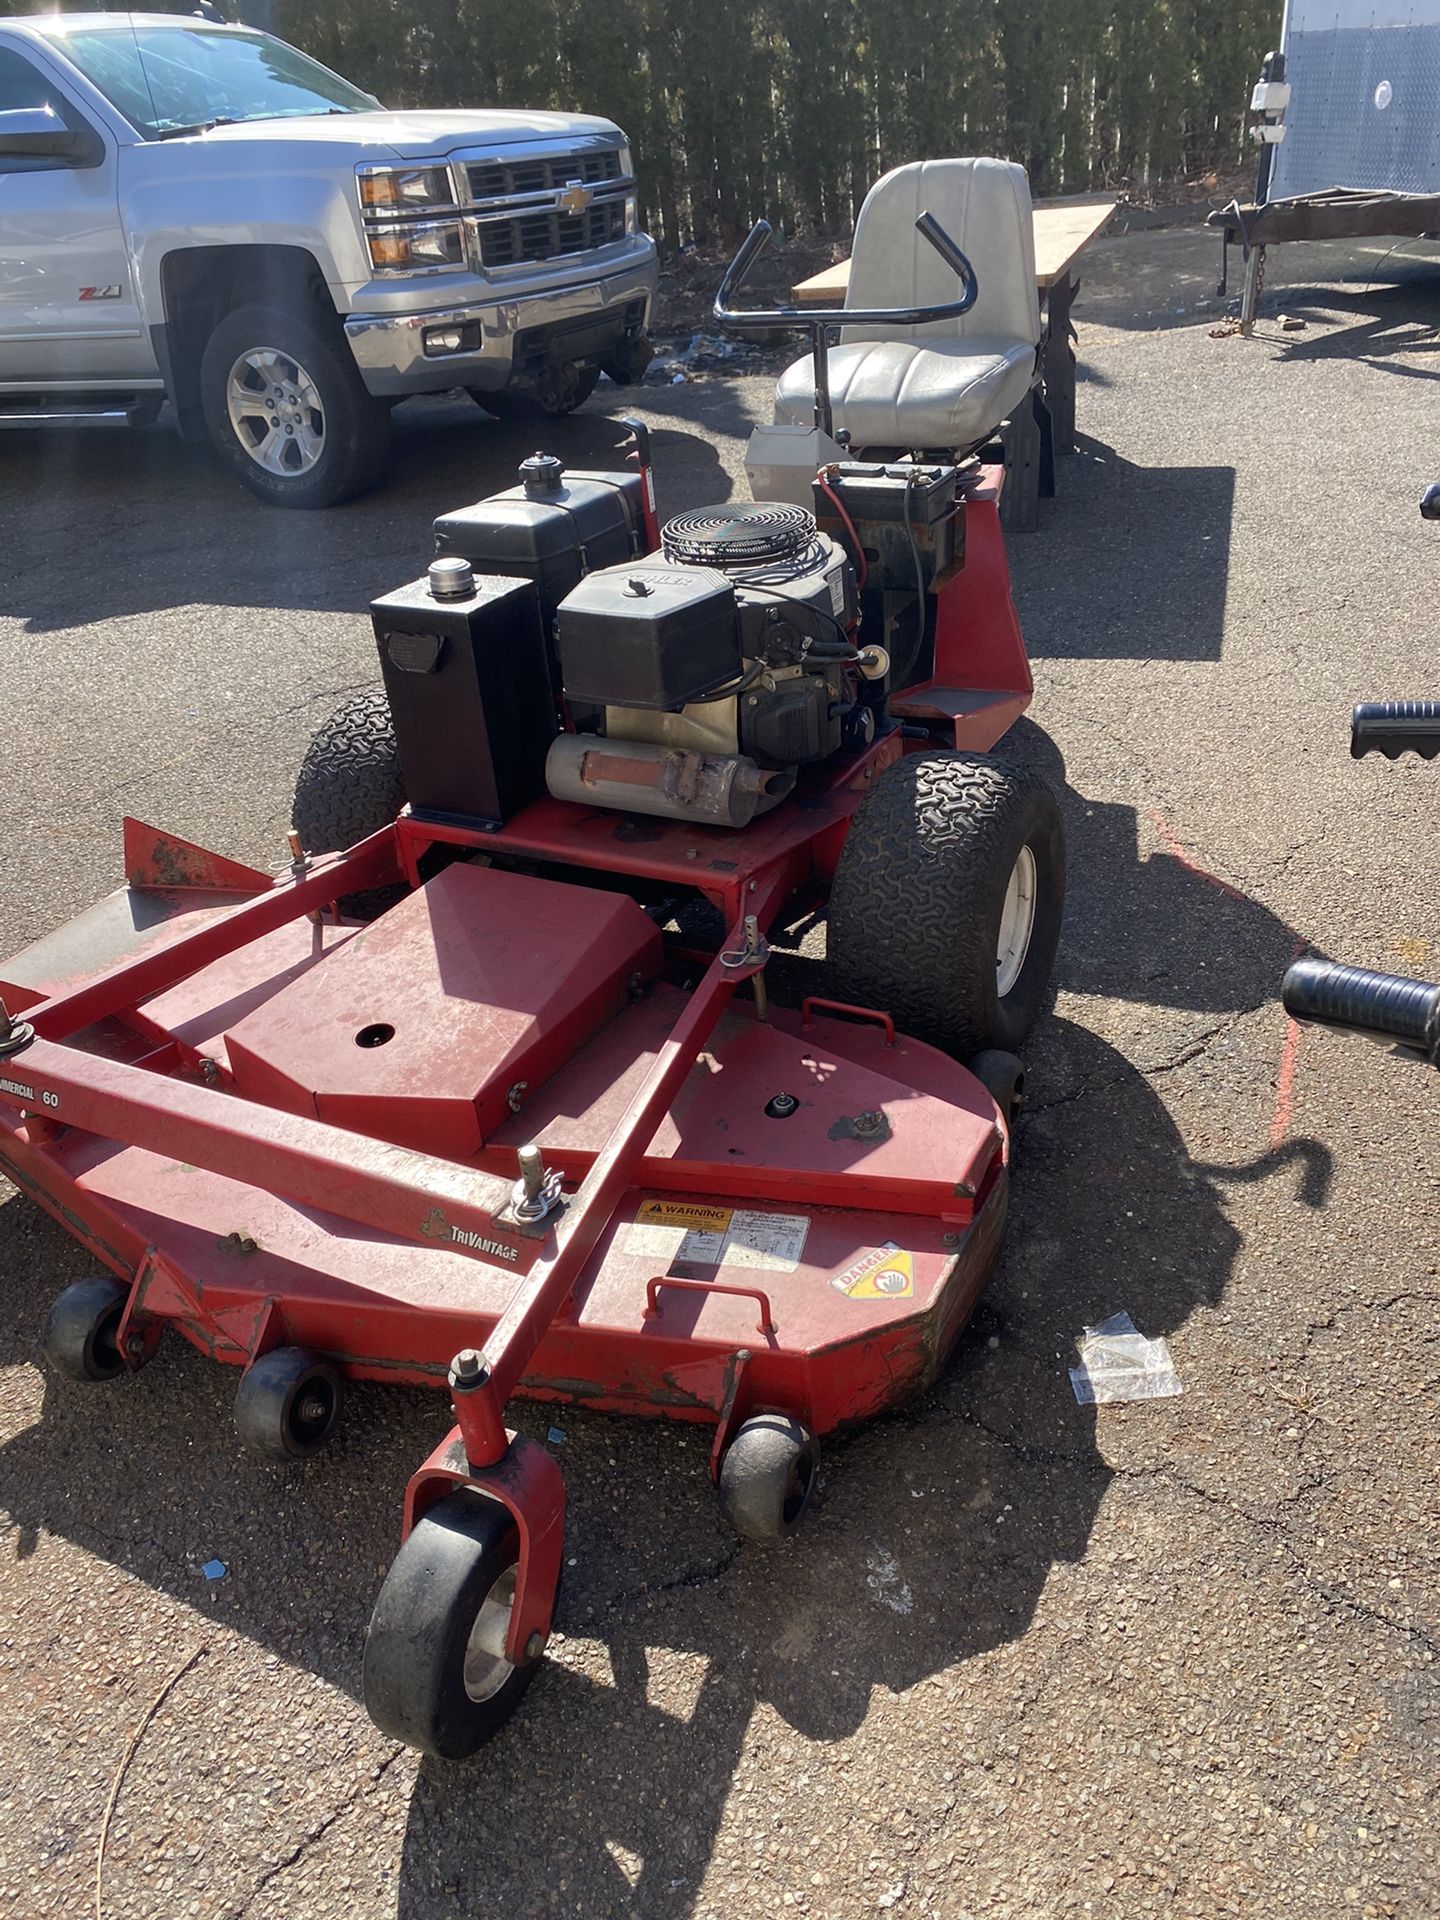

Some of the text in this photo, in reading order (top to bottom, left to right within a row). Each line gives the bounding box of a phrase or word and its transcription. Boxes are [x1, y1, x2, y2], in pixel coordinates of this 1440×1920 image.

[79, 285, 122, 301] Z71
[42, 1091, 59, 1107] 60
[666, 1205, 726, 1219] WARNING
[839, 1248, 893, 1286] DANGER
